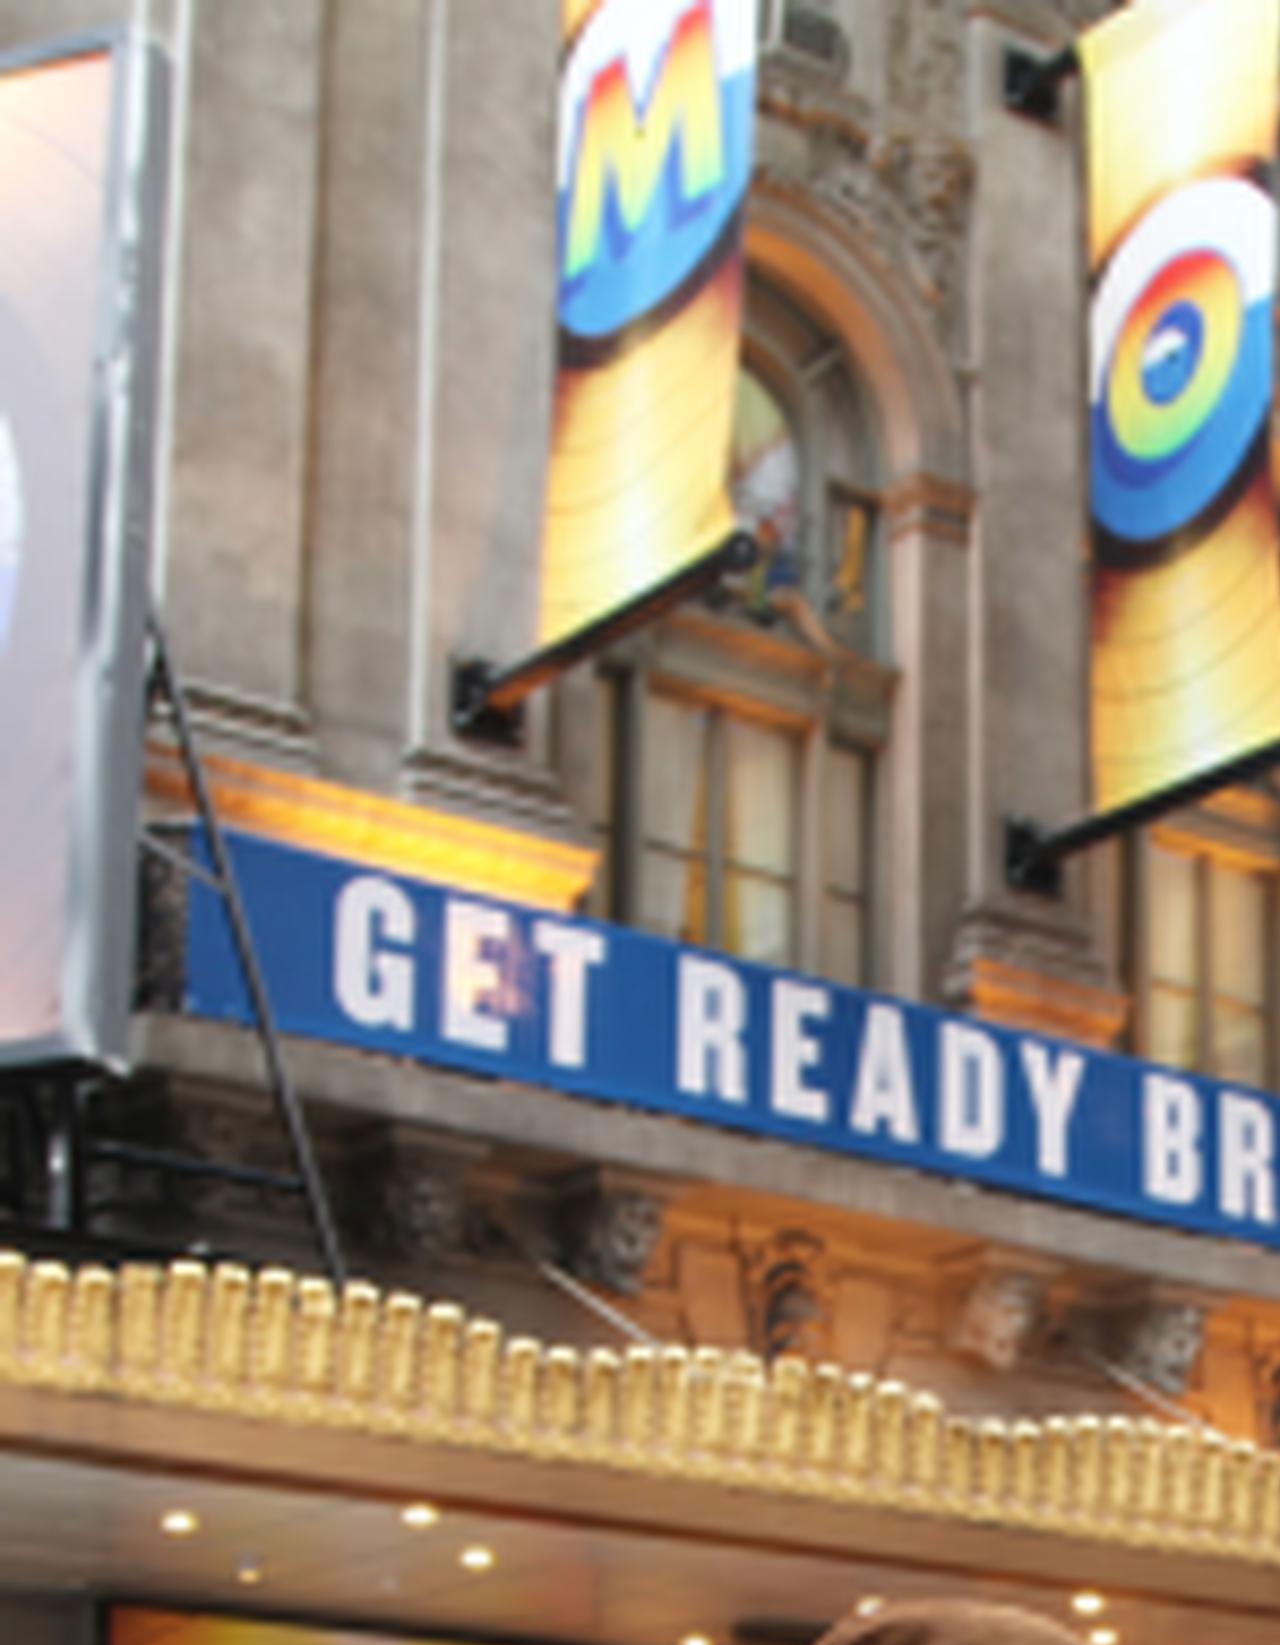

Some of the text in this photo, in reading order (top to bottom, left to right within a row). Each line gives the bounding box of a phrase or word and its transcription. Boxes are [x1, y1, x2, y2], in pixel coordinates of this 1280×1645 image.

[564, 0, 726, 278] M
[1107, 246, 1243, 462] O
[332, 873, 607, 1070] GET
[675, 953, 1085, 1179] READY
